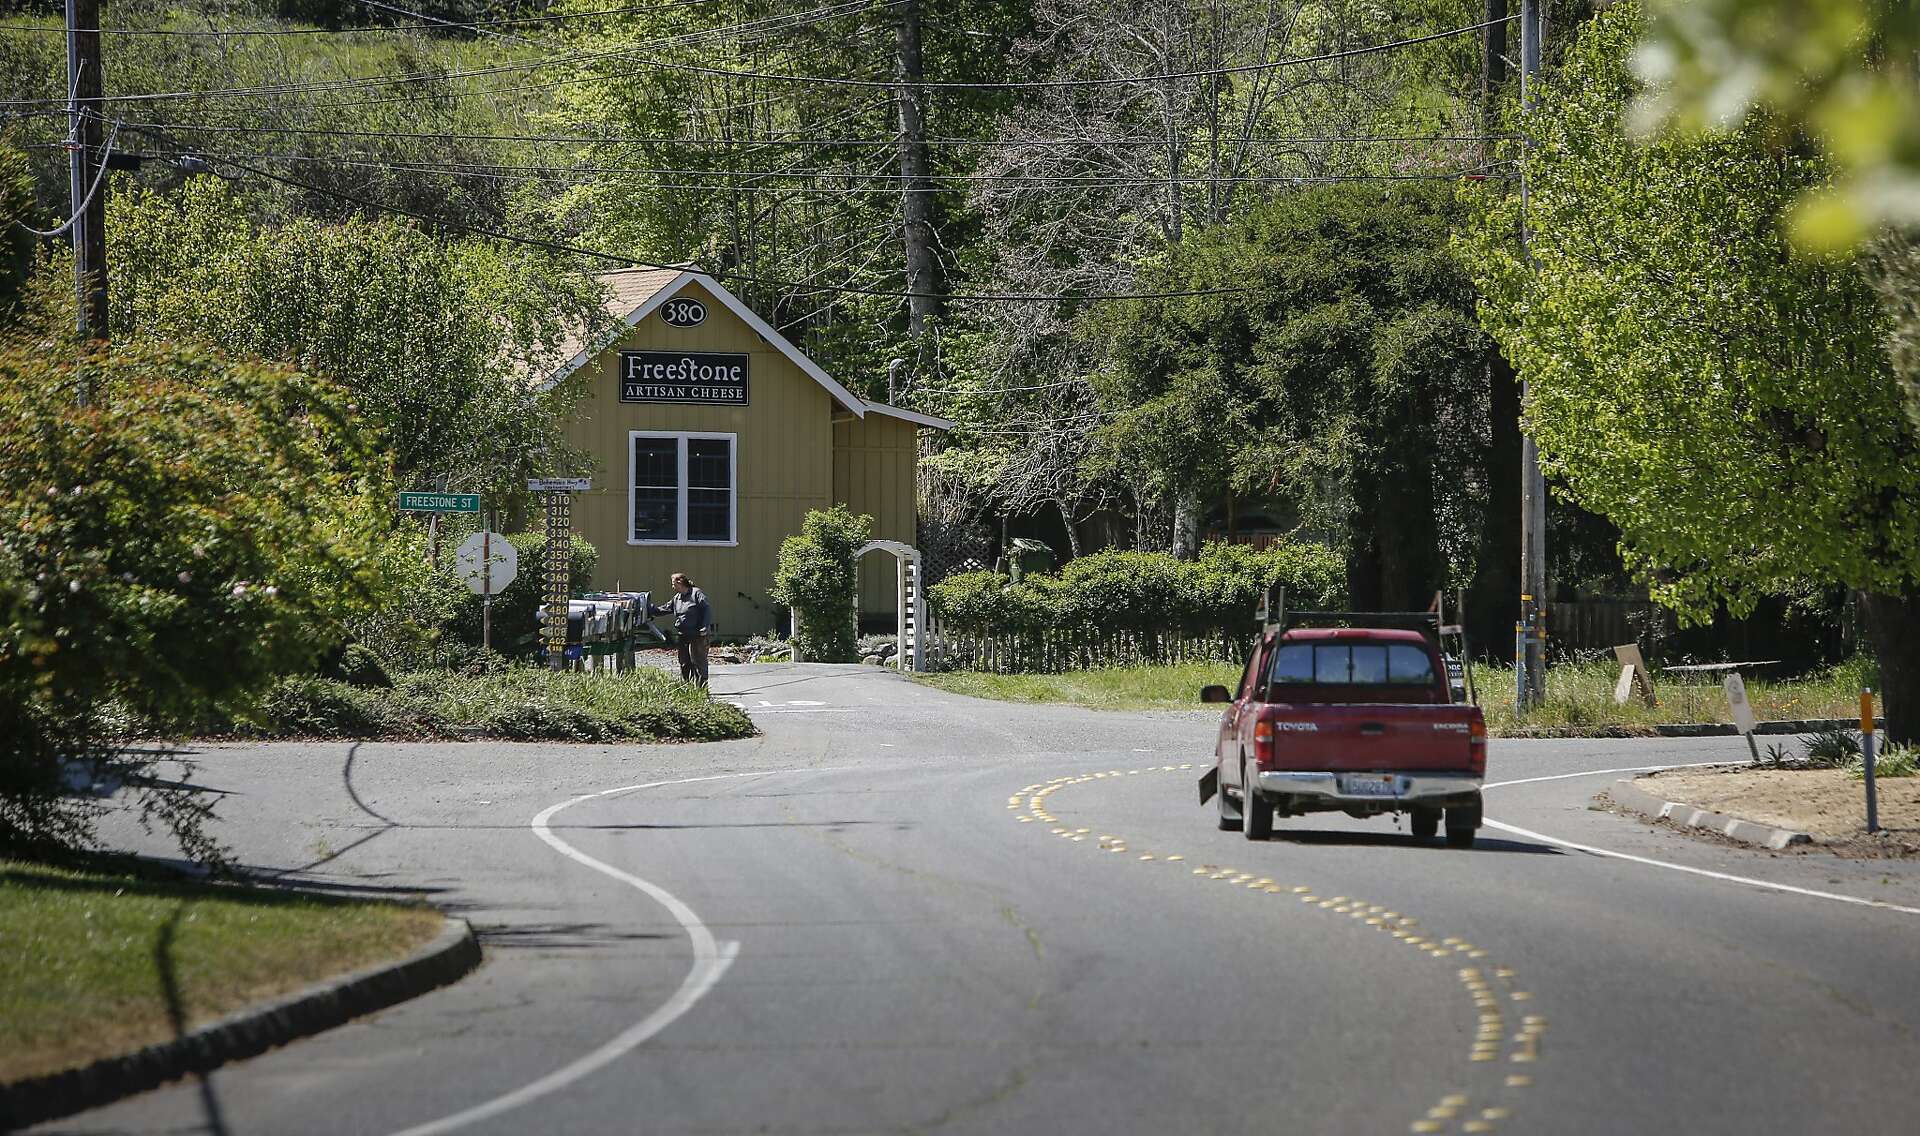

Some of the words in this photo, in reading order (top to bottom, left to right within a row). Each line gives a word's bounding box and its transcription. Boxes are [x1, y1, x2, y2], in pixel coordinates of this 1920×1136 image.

[667, 303, 704, 322] 380
[627, 355, 741, 382] Freestone
[626, 386, 685, 398] ARTISAN
[691, 387, 744, 399] CHEESE
[406, 496, 457, 508] FREESTONE
[462, 497, 473, 508] ST
[551, 496, 569, 505] 310
[551, 506, 569, 516] 316
[550, 517, 569, 527] 320
[550, 528, 569, 538] 330
[550, 539, 569, 549] 340
[550, 550, 569, 560] 350
[549, 561, 569, 571] 354
[549, 572, 569, 582] 360
[549, 583, 568, 593] 413
[548, 594, 568, 604] 440
[547, 616, 567, 626] 400
[548, 637, 566, 645] 402
[1275, 721, 1318, 732] TOYOTA
